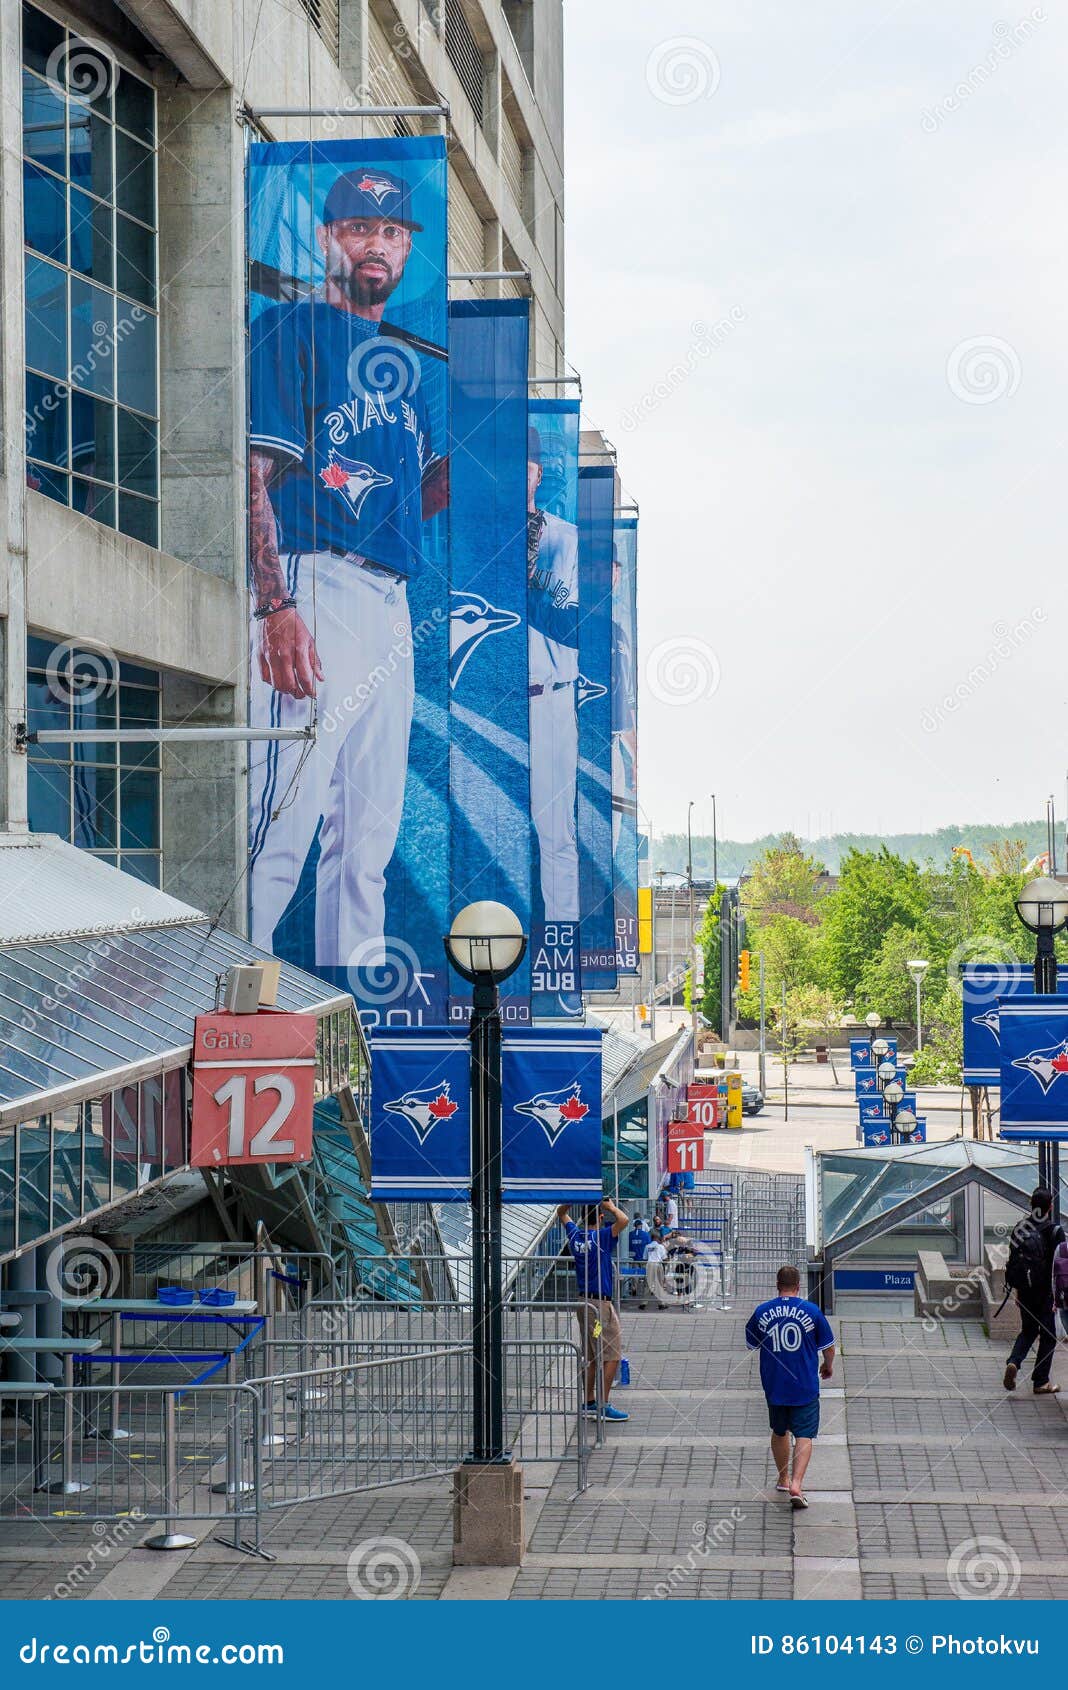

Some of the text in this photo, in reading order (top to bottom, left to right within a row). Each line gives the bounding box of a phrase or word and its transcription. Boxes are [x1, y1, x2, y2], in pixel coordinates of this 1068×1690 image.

[202, 1028, 252, 1049] Gate
[214, 1073, 296, 1157] 12
[692, 1102, 714, 1126] 10
[676, 1142, 697, 1170] 11
[884, 1274, 911, 1285] Plaza
[758, 1305, 815, 1333] ENCARNACION
[767, 1322, 802, 1353] 10
